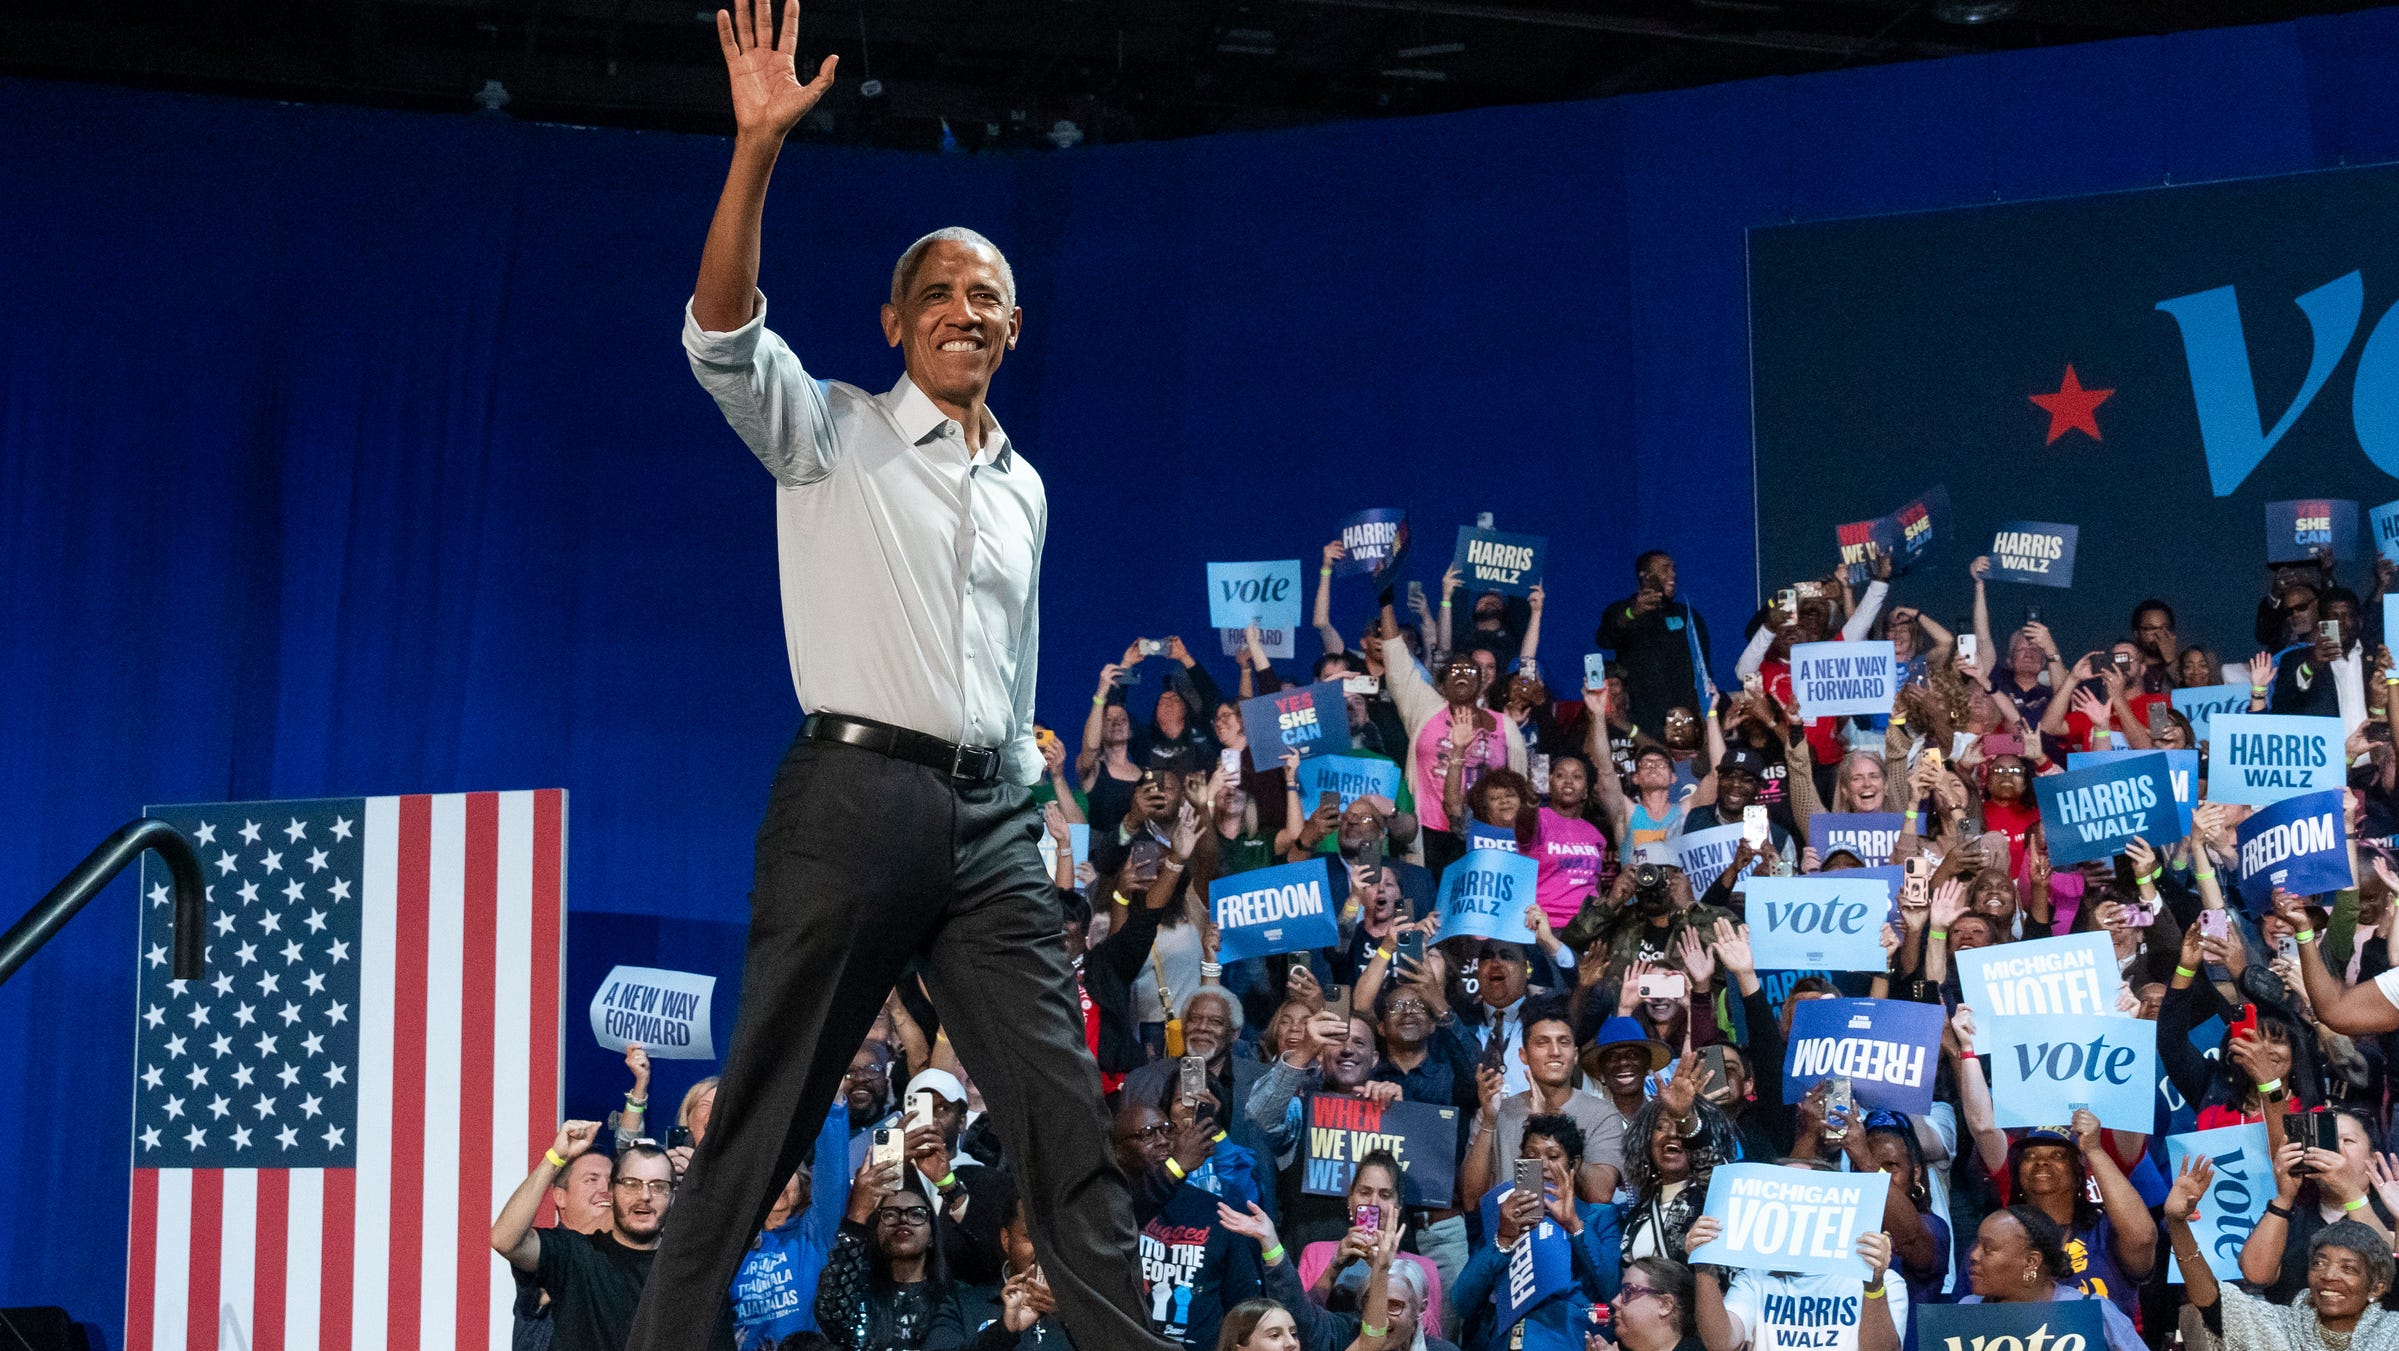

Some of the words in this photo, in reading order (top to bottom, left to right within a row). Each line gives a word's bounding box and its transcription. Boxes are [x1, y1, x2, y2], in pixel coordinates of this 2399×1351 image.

[1343, 521, 1398, 550] HARRIS
[1904, 515, 1931, 541] SHE
[2295, 517, 2330, 531] SHE
[2295, 530, 2332, 545] CAN
[1467, 539, 1534, 572] HARRIS
[1993, 532, 2063, 560] HARRIS
[1475, 565, 1520, 585] WALZ
[2001, 554, 2049, 574] WALZ
[1221, 573, 1290, 603] vote
[1228, 628, 1282, 646] FORARD
[1801, 660, 1811, 681] A
[1815, 658, 1851, 680] NEW
[1856, 656, 1887, 676] WAY
[1275, 692, 1313, 713] YES
[1807, 678, 1884, 702] FORWARD
[1278, 707, 1318, 730] SHE
[1281, 722, 1321, 746] CAN
[2230, 733, 2327, 768] HARRIS
[1317, 768, 1381, 796] HARRIS
[2244, 769, 2313, 788] WALZ
[2056, 774, 2158, 825] HARRIS
[2078, 812, 2149, 842] WALZ
[1687, 842, 1724, 870] NEW
[2242, 812, 2336, 881] FREEDOM
[1451, 869, 1514, 902] HARRIS
[1217, 880, 1324, 930] FREEDOM
[1452, 898, 1500, 917] WALZ
[1764, 894, 1868, 935] vote
[1982, 948, 2095, 982] MICHIGAN
[602, 982, 620, 1007] A
[618, 983, 661, 1014] NEW
[660, 989, 701, 1022] WAY
[605, 1008, 691, 1047] FORWARD
[1791, 1037, 1926, 1088] FREEDOM
[2013, 1034, 2136, 1085] vote
[1313, 1095, 1381, 1133] WHEN
[1310, 1127, 1347, 1161] WE
[1308, 1158, 1344, 1193] WE
[1731, 1177, 1862, 1205] MICHIGAN
[2212, 1146, 2257, 1261] vote
[1143, 1217, 1210, 1248] lugged
[1726, 1197, 1858, 1259] VOTE!
[1170, 1244, 1205, 1268] THE
[1141, 1256, 1197, 1288] EOPLE
[1764, 1293, 1858, 1328] HARRIS
[1776, 1329, 1840, 1349] WALZ
